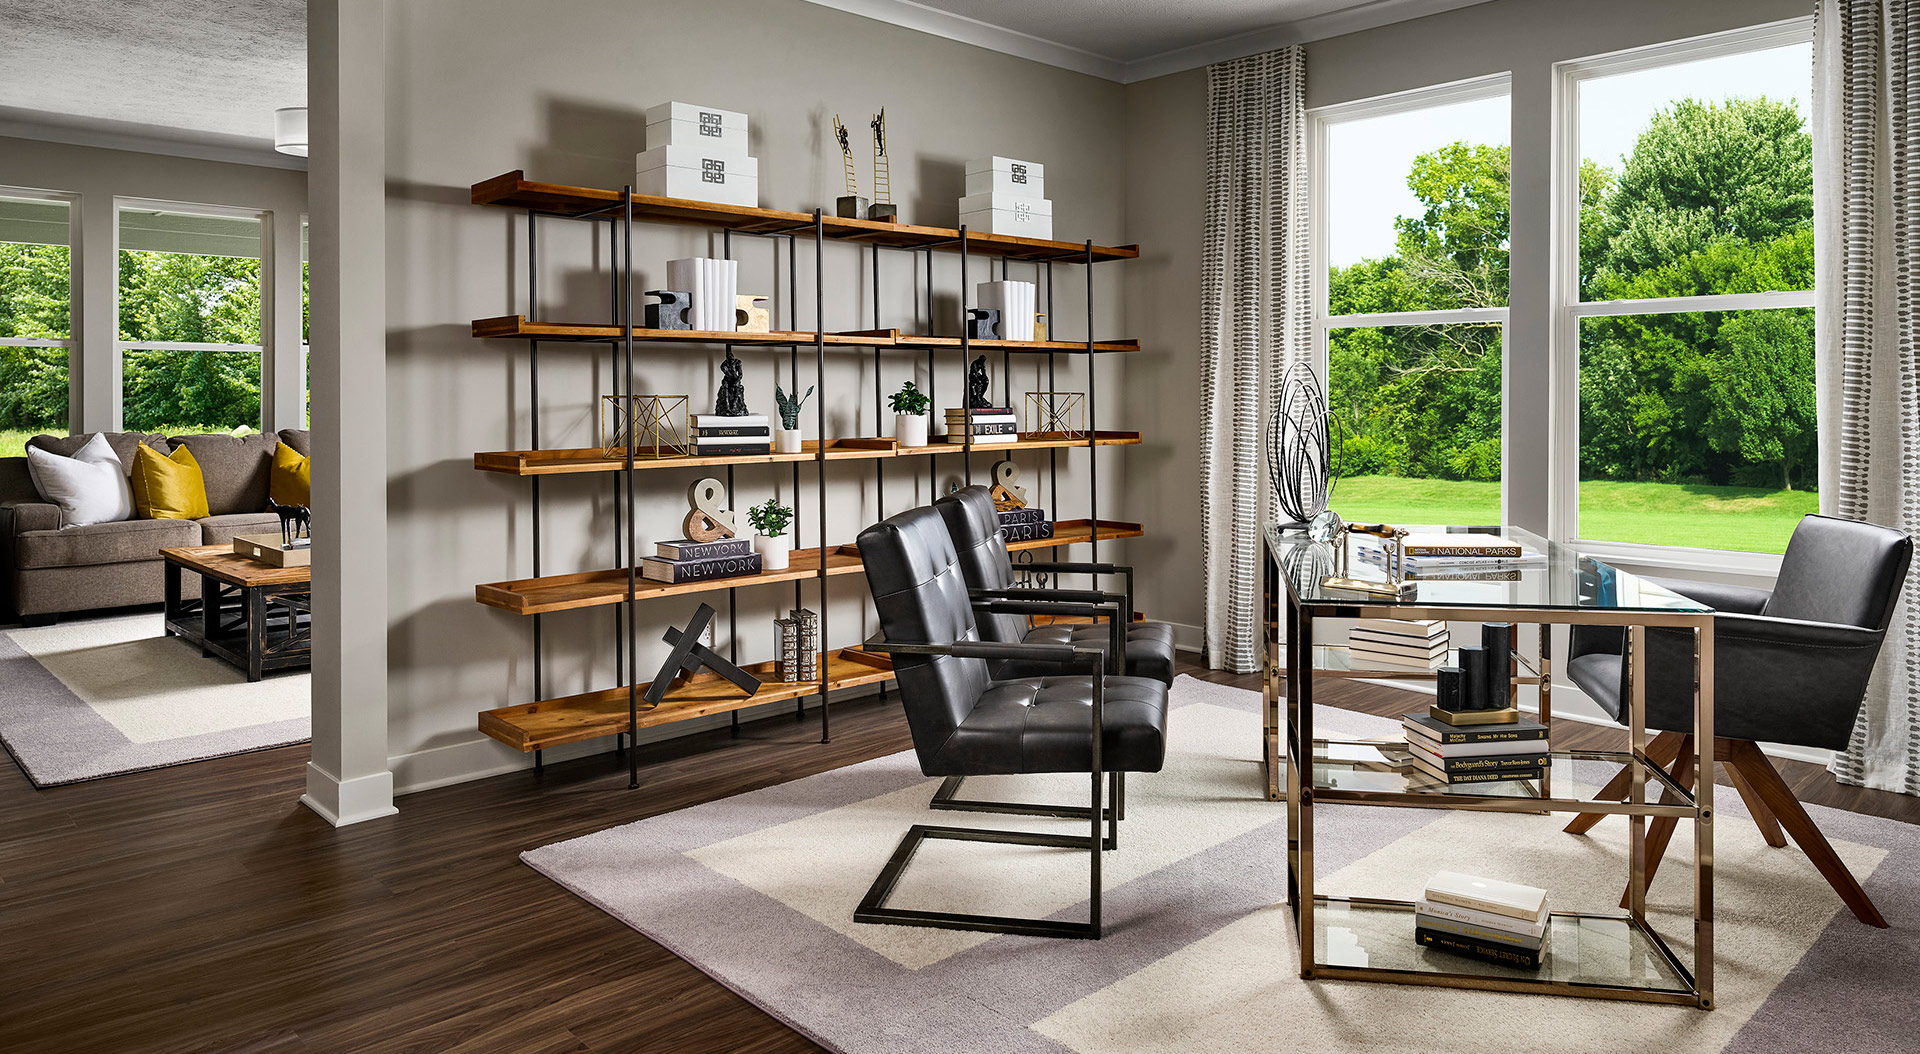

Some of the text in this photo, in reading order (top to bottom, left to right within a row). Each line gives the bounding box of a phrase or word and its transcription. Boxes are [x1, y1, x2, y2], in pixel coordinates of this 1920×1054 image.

[985, 424, 1003, 435] EXILE
[1004, 511, 1039, 524] PARIS
[685, 543, 744, 559] NEW YORK
[1437, 547, 1517, 556] NATIONAL PARKS
[681, 558, 756, 578] NEW YORK
[1455, 760, 1484, 770] Bodyguard's
[1484, 759, 1499, 769] Story
[1427, 906, 1472, 921] Monica's Story
[1476, 945, 1498, 959] SERVICE
[1498, 951, 1520, 963] SECRET
